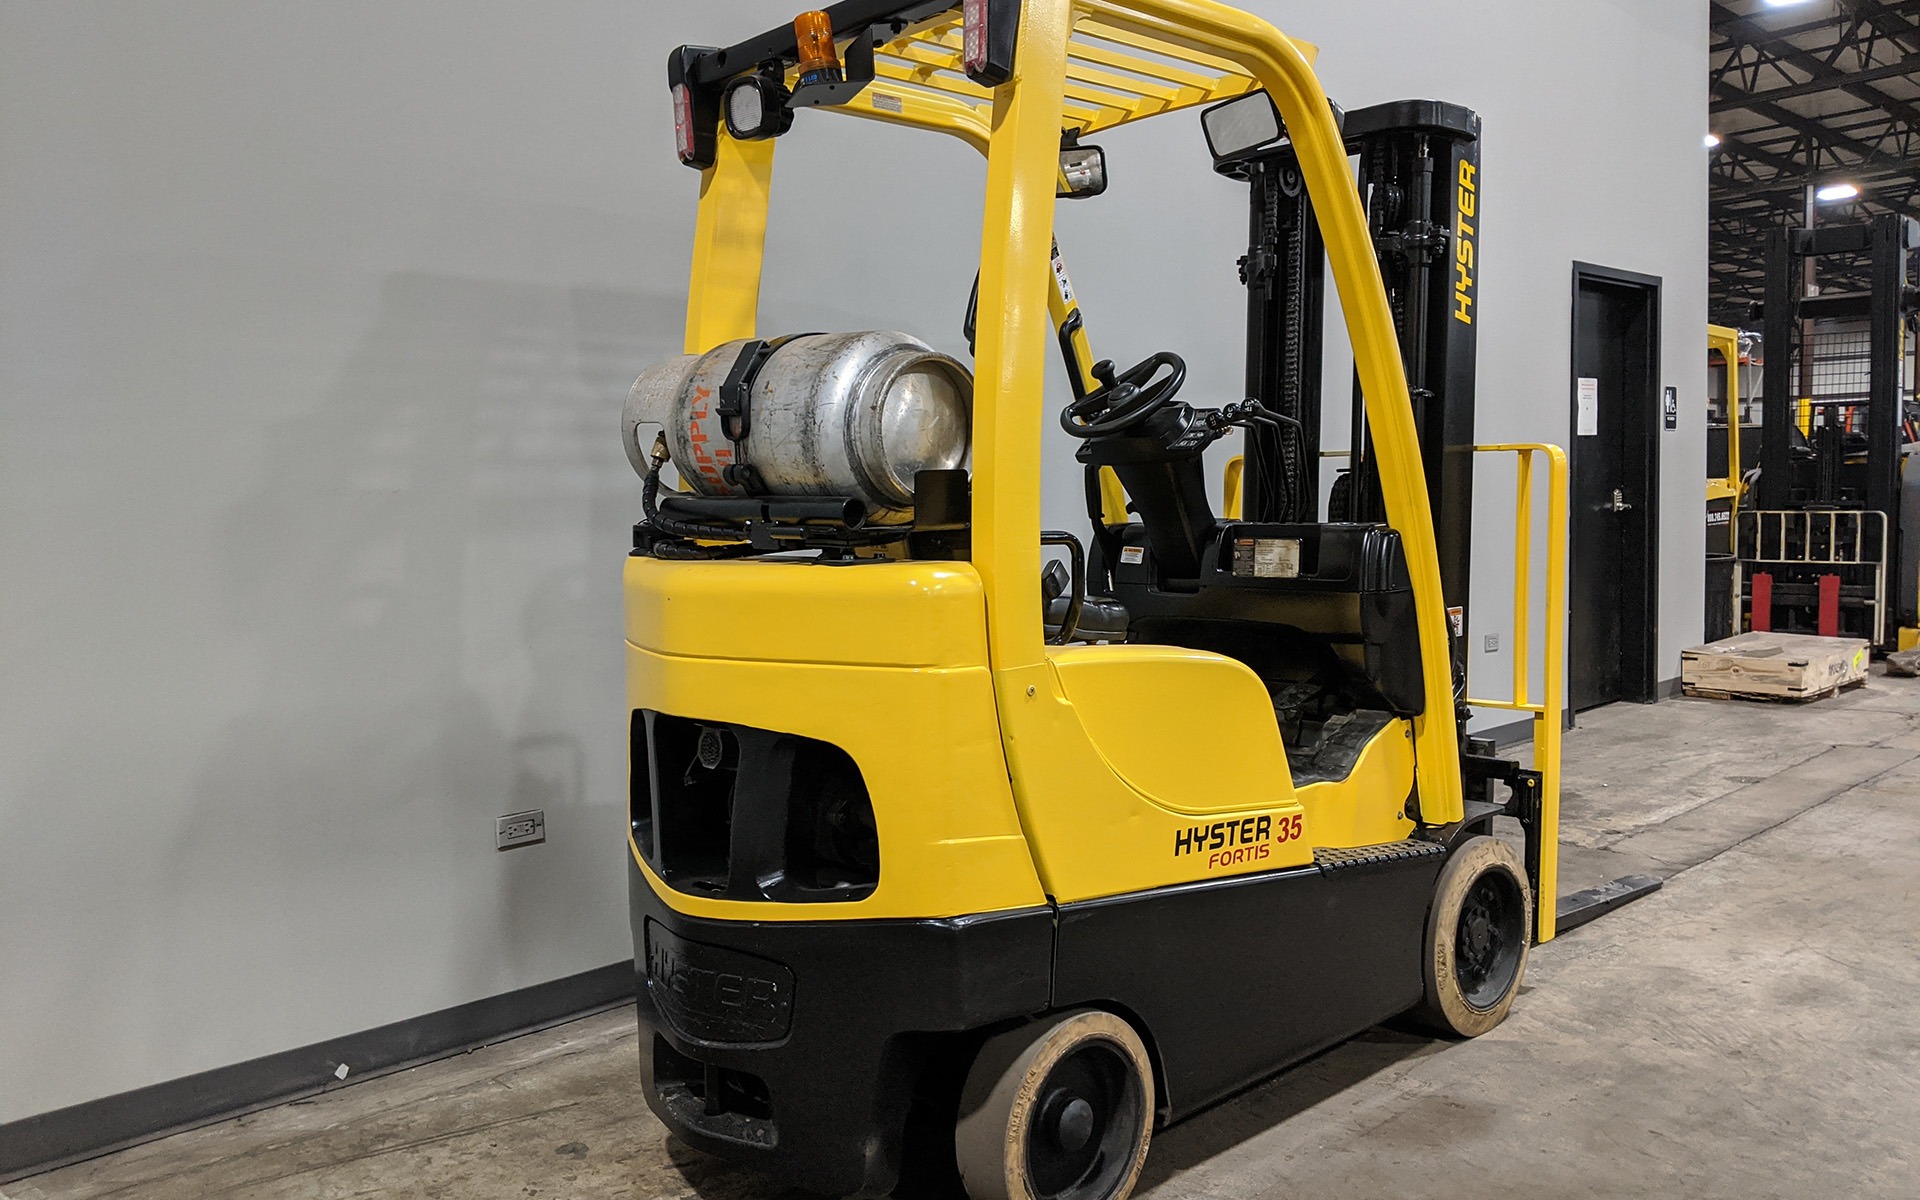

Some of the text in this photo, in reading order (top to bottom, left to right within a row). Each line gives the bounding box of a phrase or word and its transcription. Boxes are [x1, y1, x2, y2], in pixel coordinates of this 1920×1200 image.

[1455, 159, 1476, 325] HYSTER
[1174, 814, 1303, 857] HYSTER 35
[1209, 844, 1270, 869] FORTIS
